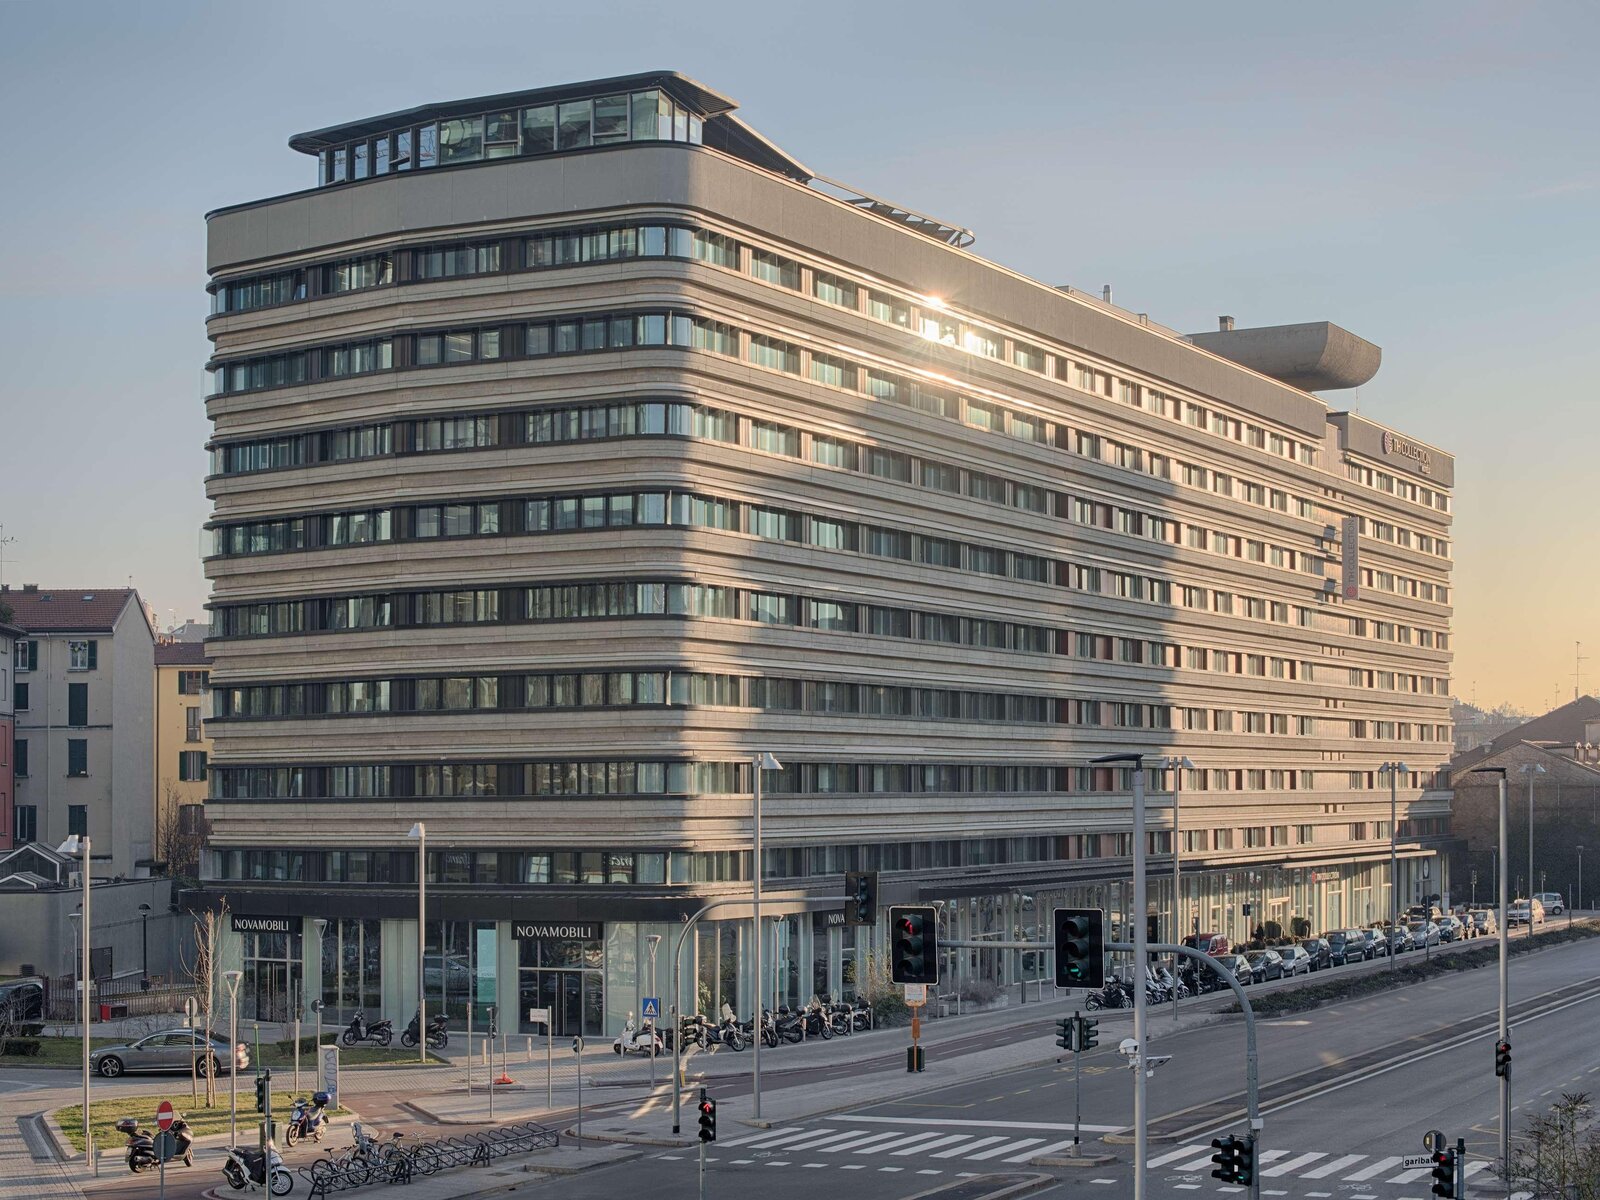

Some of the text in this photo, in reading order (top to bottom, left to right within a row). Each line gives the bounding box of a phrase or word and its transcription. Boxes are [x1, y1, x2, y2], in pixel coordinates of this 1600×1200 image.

[828, 913, 845, 924] NOVA
[234, 919, 289, 931] NOVAMOBILI
[516, 925, 591, 938] NOVAMOBILI
[1404, 1156, 1435, 1167] garibal
